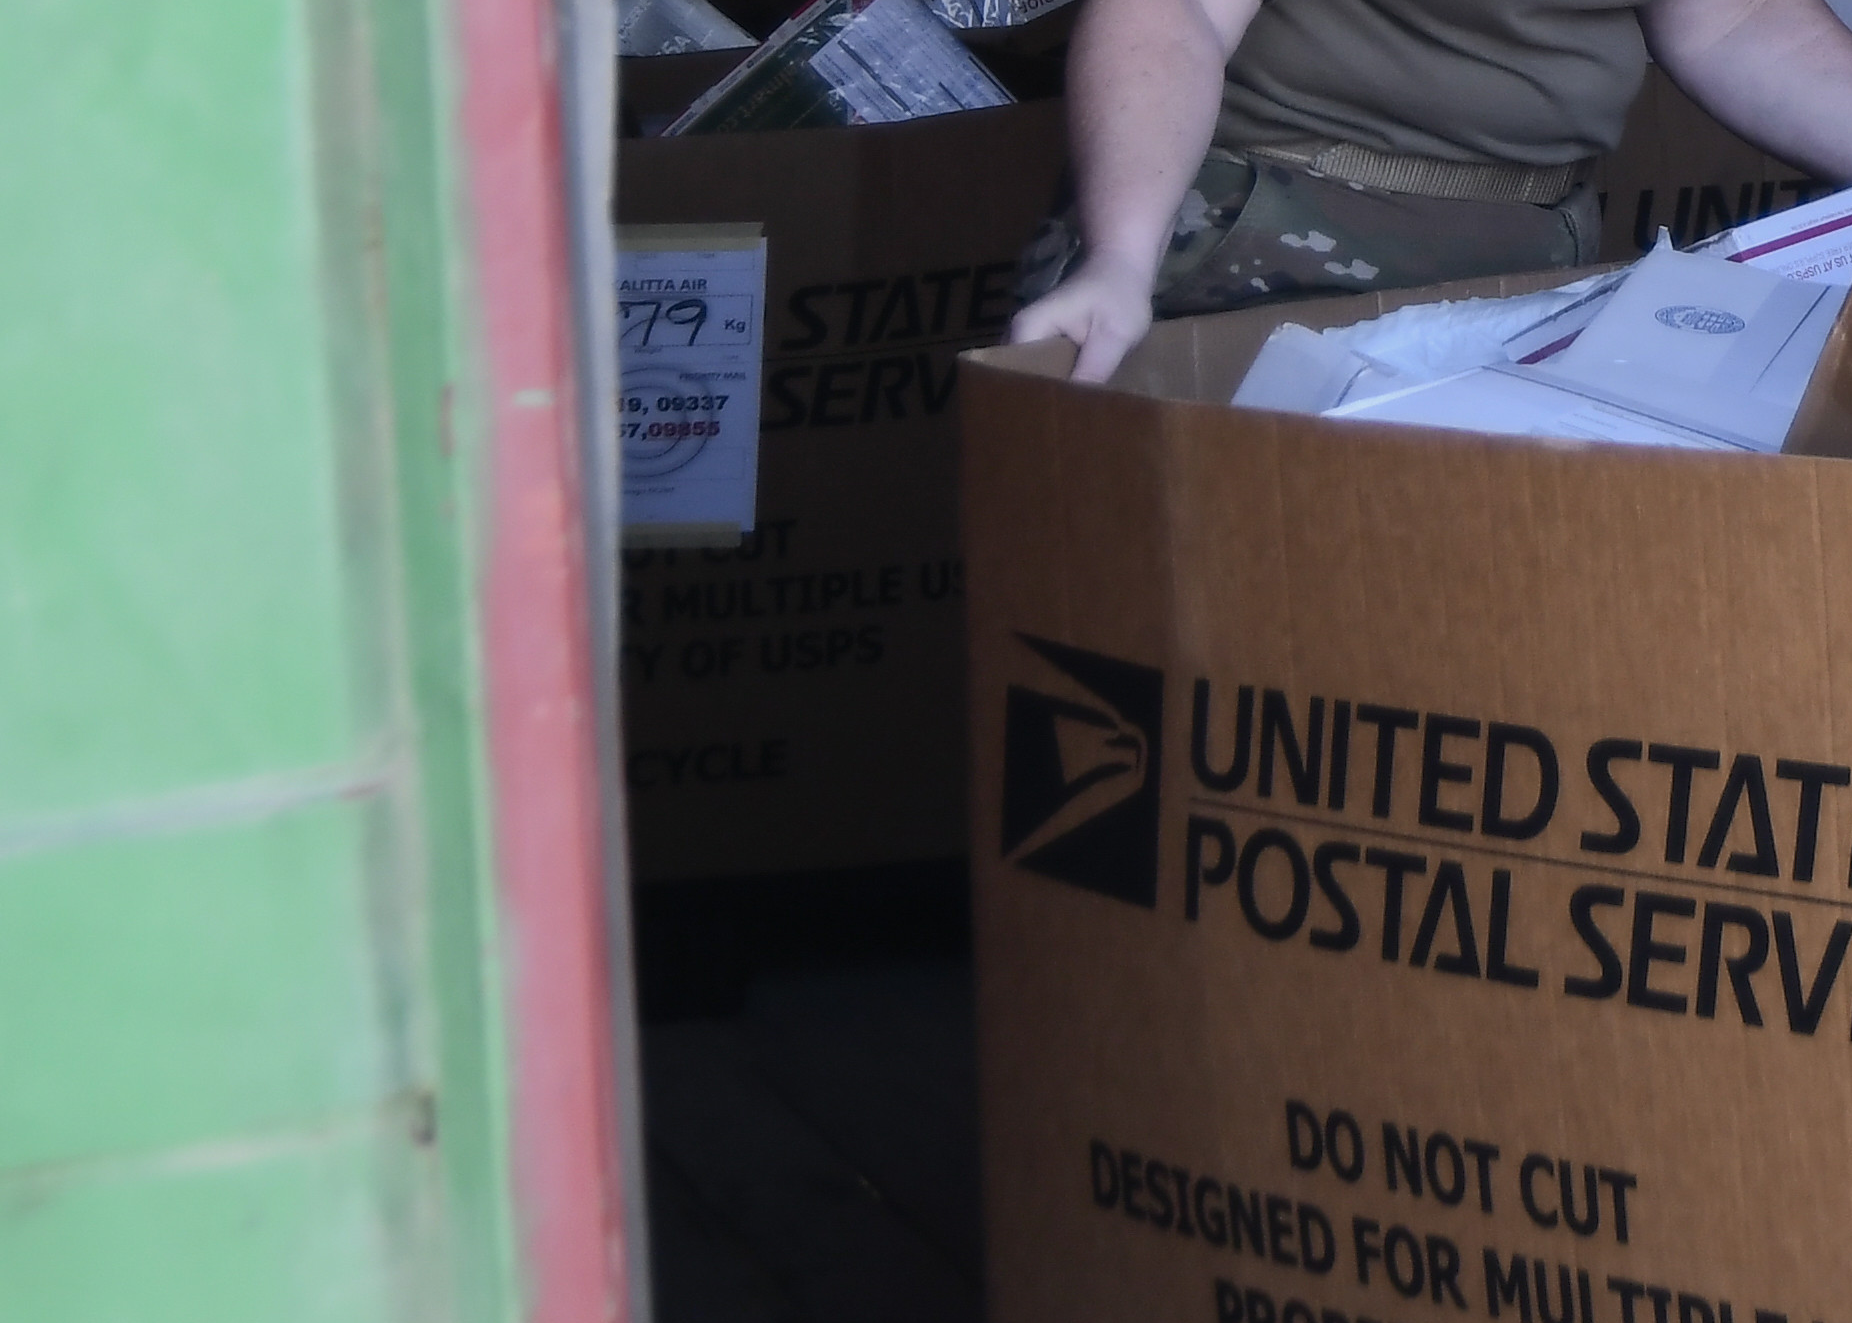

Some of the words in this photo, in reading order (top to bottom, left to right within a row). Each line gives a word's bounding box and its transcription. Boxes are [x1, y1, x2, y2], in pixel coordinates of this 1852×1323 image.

[1634, 177, 1816, 253] UNIT
[619, 279, 675, 291] ALITTA
[680, 279, 708, 291] AIR
[1823, 260, 1833, 273] AT
[1834, 255, 1848, 268] US
[724, 319, 746, 333] Kg
[781, 261, 1016, 350] STATE
[760, 352, 958, 430] SERV
[664, 564, 903, 619] MULTIPLE
[682, 638, 743, 679] OF
[761, 625, 885, 672] USPS
[629, 739, 788, 790] CYCLE
[1191, 679, 1560, 839] UNITED
[1184, 815, 1540, 987] POSTAL
[1285, 1098, 1364, 1184] DO
[1381, 1121, 1499, 1213] NOT
[1518, 1153, 1638, 1245] CUT
[1089, 1140, 1337, 1277] DESIGNED
[1352, 1215, 1469, 1314] FOR
